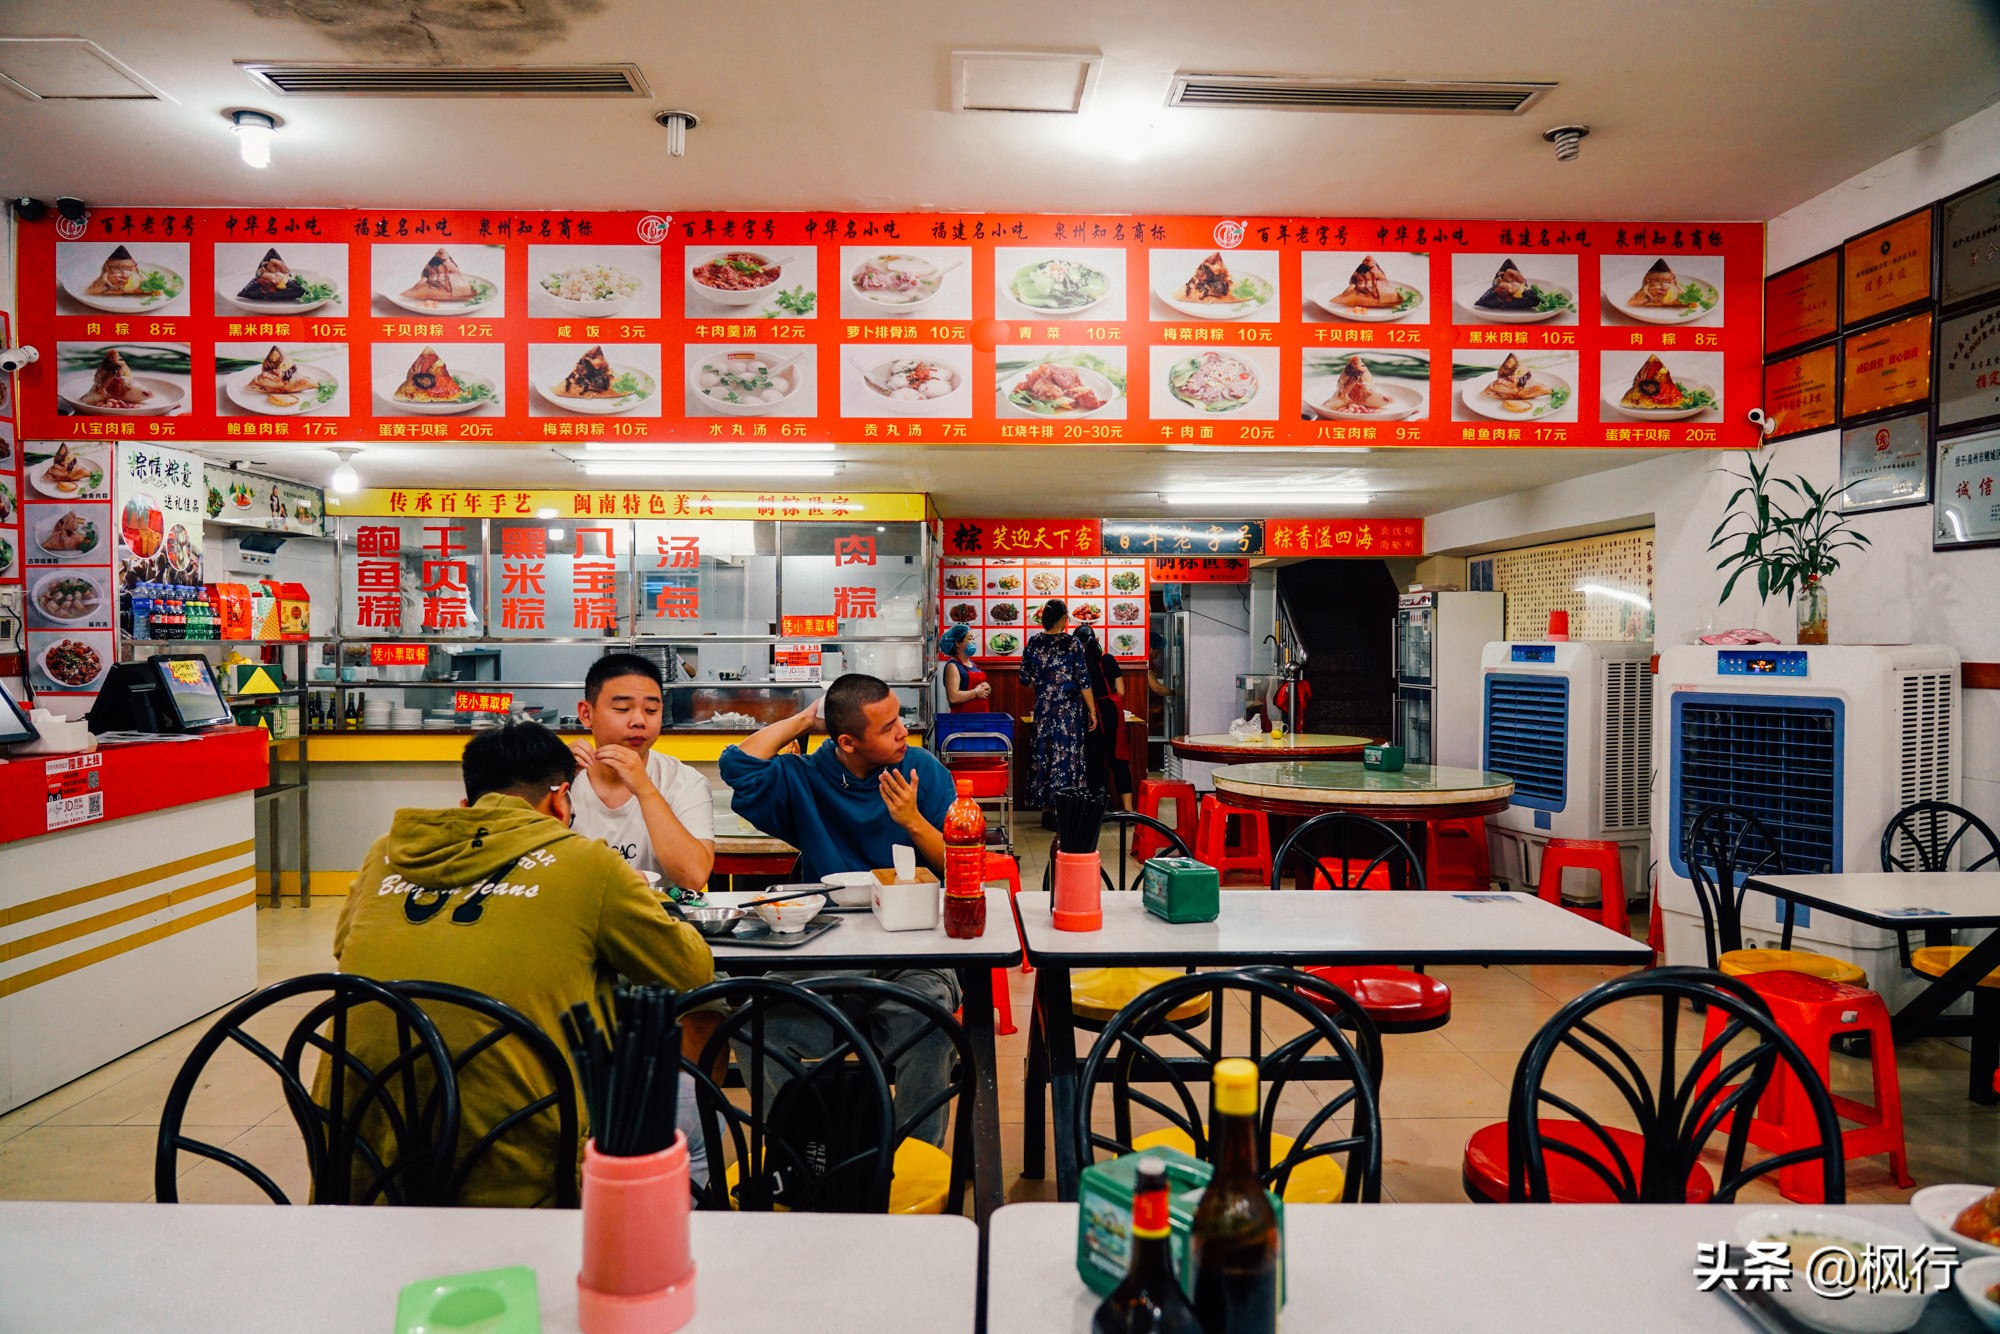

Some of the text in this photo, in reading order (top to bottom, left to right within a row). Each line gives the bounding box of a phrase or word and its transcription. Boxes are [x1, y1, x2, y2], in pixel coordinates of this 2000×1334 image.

[100, 215, 592, 238] 百年老字号 中华名小吃 福建名小吃 泉州知名商标
[682, 219, 1167, 241] 百年老字号 中华名小吃 福建名小吃 泉州知名商标
[1256, 225, 1723, 250] 百年老字号 中华名小吃 福建名小吃 泉州知名商标
[87, 322, 177, 336] 肉粽 8元
[228, 323, 347, 337] 黑米肉粽 10元
[382, 323, 493, 337] 干贝肉粽 12元
[557, 324, 646, 338] 咸饭 3元
[695, 324, 806, 338] 牛肉羹汤 12元
[846, 325, 965, 339] 萝卜排骨汤 10元
[1019, 326, 1121, 340] 青菜 10元
[1163, 327, 1273, 341] 梅菜肉粽 10元
[1314, 329, 1421, 343] 干贝肉粽 12元
[1469, 331, 1575, 345] 黑米肉粽 10元
[1630, 332, 1718, 346] 肉粽 8元
[72, 422, 176, 436] 八宝肉粽 9元
[226, 422, 338, 436] 鲍鱼肉粽 17元
[378, 423, 494, 437] 蛋黄干贝粽 20元
[543, 422, 648, 436] 梅菜肉粽 10元
[709, 423, 807, 437] 水丸汤 6元
[864, 423, 967, 437] 贡丸汤 7元
[1001, 424, 1123, 438] 红烧牛排 20-30元
[1160, 425, 1275, 439] 牛肉面 20元
[1317, 426, 1421, 440] 八宝肉粽 9元
[1462, 427, 1567, 441] 鲍鱼肉粽 17元
[1605, 428, 1717, 441] 蛋黄干贝粽 20元
[164, 494, 199, 513] 送礼佳品
[390, 491, 532, 513] 传承百年手艺
[573, 492, 714, 517] 闽南特色美食
[992, 525, 1094, 551] 笑迎天下客
[1117, 522, 1251, 552] 百年老字号
[1273, 525, 1373, 550] 粽香溢四海
[357, 525, 401, 628] 鲍鱼粽
[423, 526, 467, 628] 干贝粽
[502, 527, 546, 629] 黑米粽
[573, 527, 617, 629] 八宝粽
[655, 535, 700, 618] 汤点
[834, 534, 877, 619] 肉粽
[783, 619, 835, 633] 凭小票取餐
[373, 646, 428, 662] 凭小票取餐
[457, 693, 512, 711] 凭小票取餐
[463, 879, 541, 901] jeans
